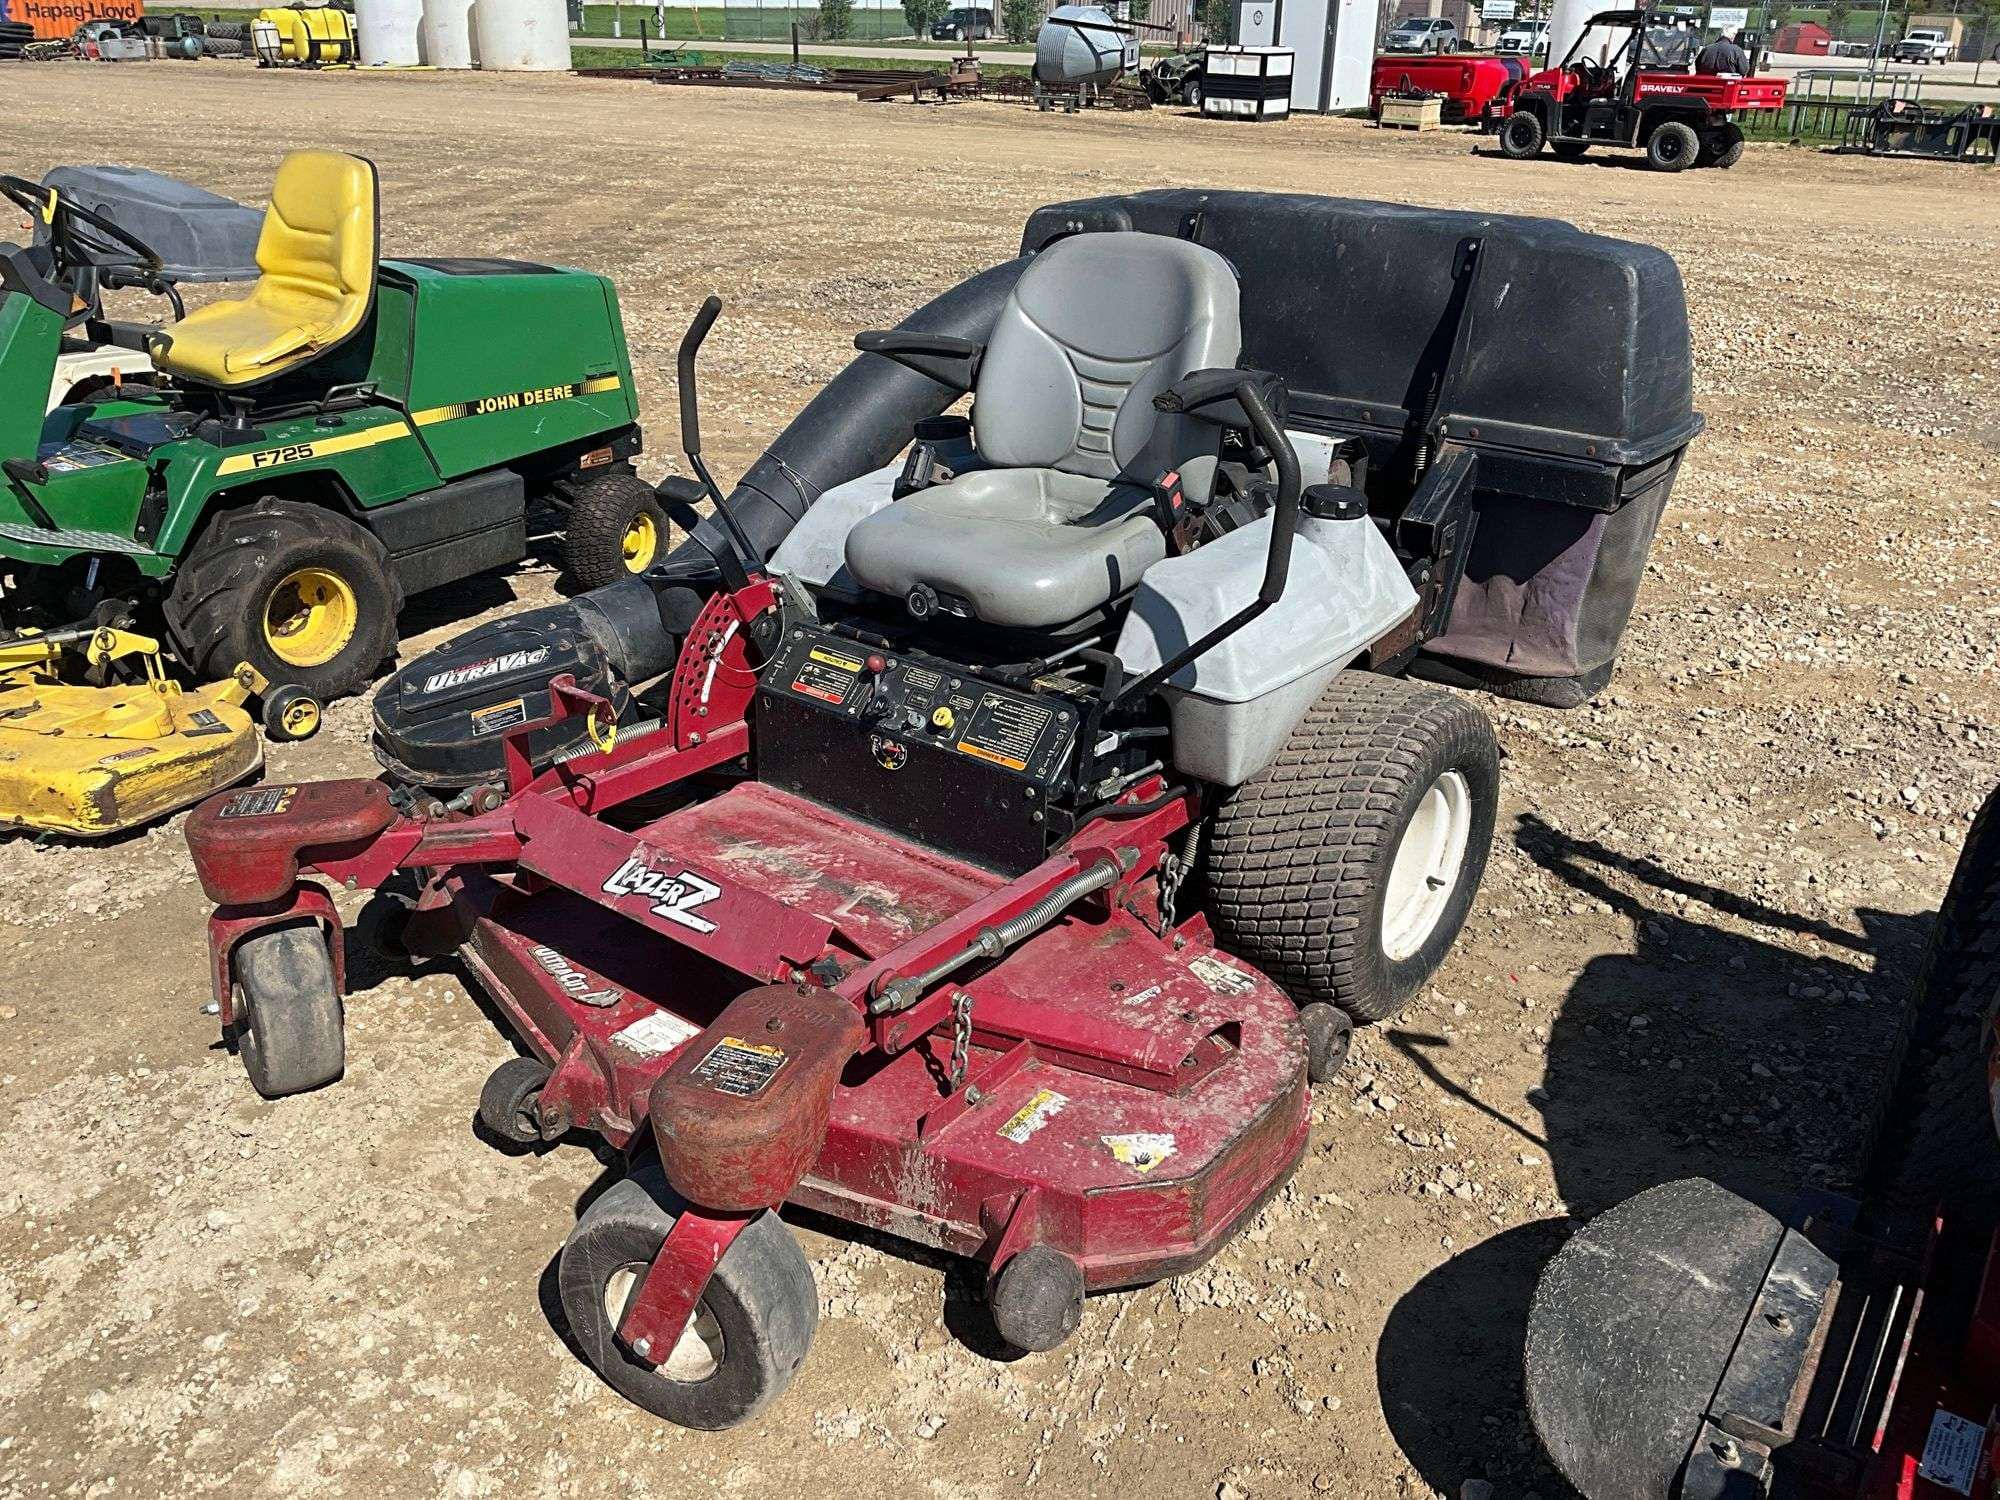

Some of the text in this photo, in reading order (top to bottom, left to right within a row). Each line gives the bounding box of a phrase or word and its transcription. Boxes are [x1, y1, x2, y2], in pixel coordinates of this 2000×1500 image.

[25, 2, 136, 20] Hapag-Lloyd
[1640, 84, 1685, 93] GRAVELY
[476, 384, 573, 414] JOHN DEERE
[253, 443, 314, 468] F725
